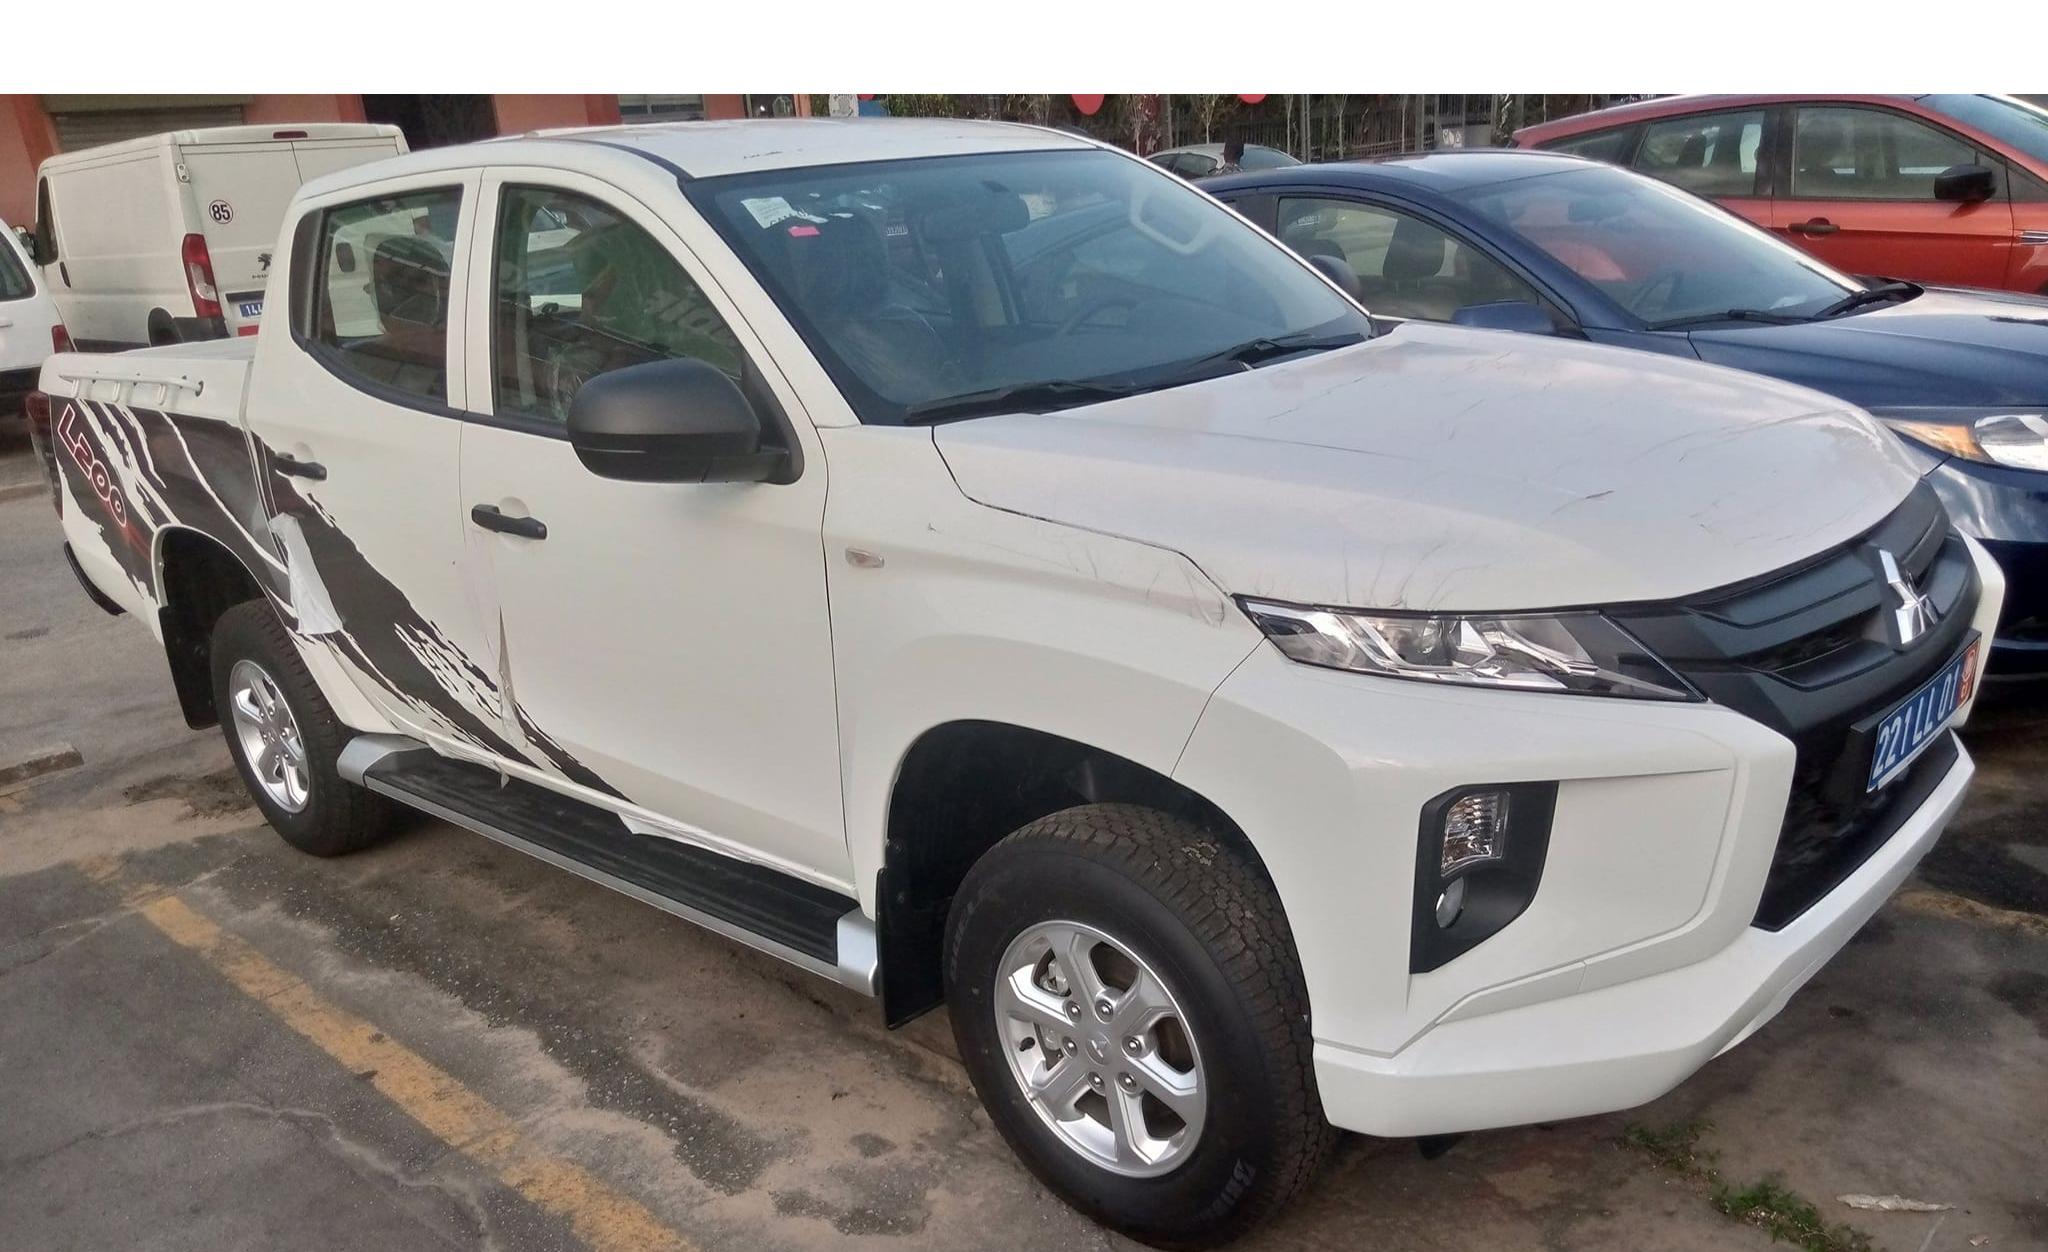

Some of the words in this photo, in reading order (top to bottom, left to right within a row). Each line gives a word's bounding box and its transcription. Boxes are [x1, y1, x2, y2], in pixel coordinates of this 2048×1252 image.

[211, 204, 231, 221] 85
[57, 403, 127, 528] L200
[1872, 705, 1912, 779] 221
[1912, 687, 1936, 746] LL
[1937, 663, 1960, 721] 01
